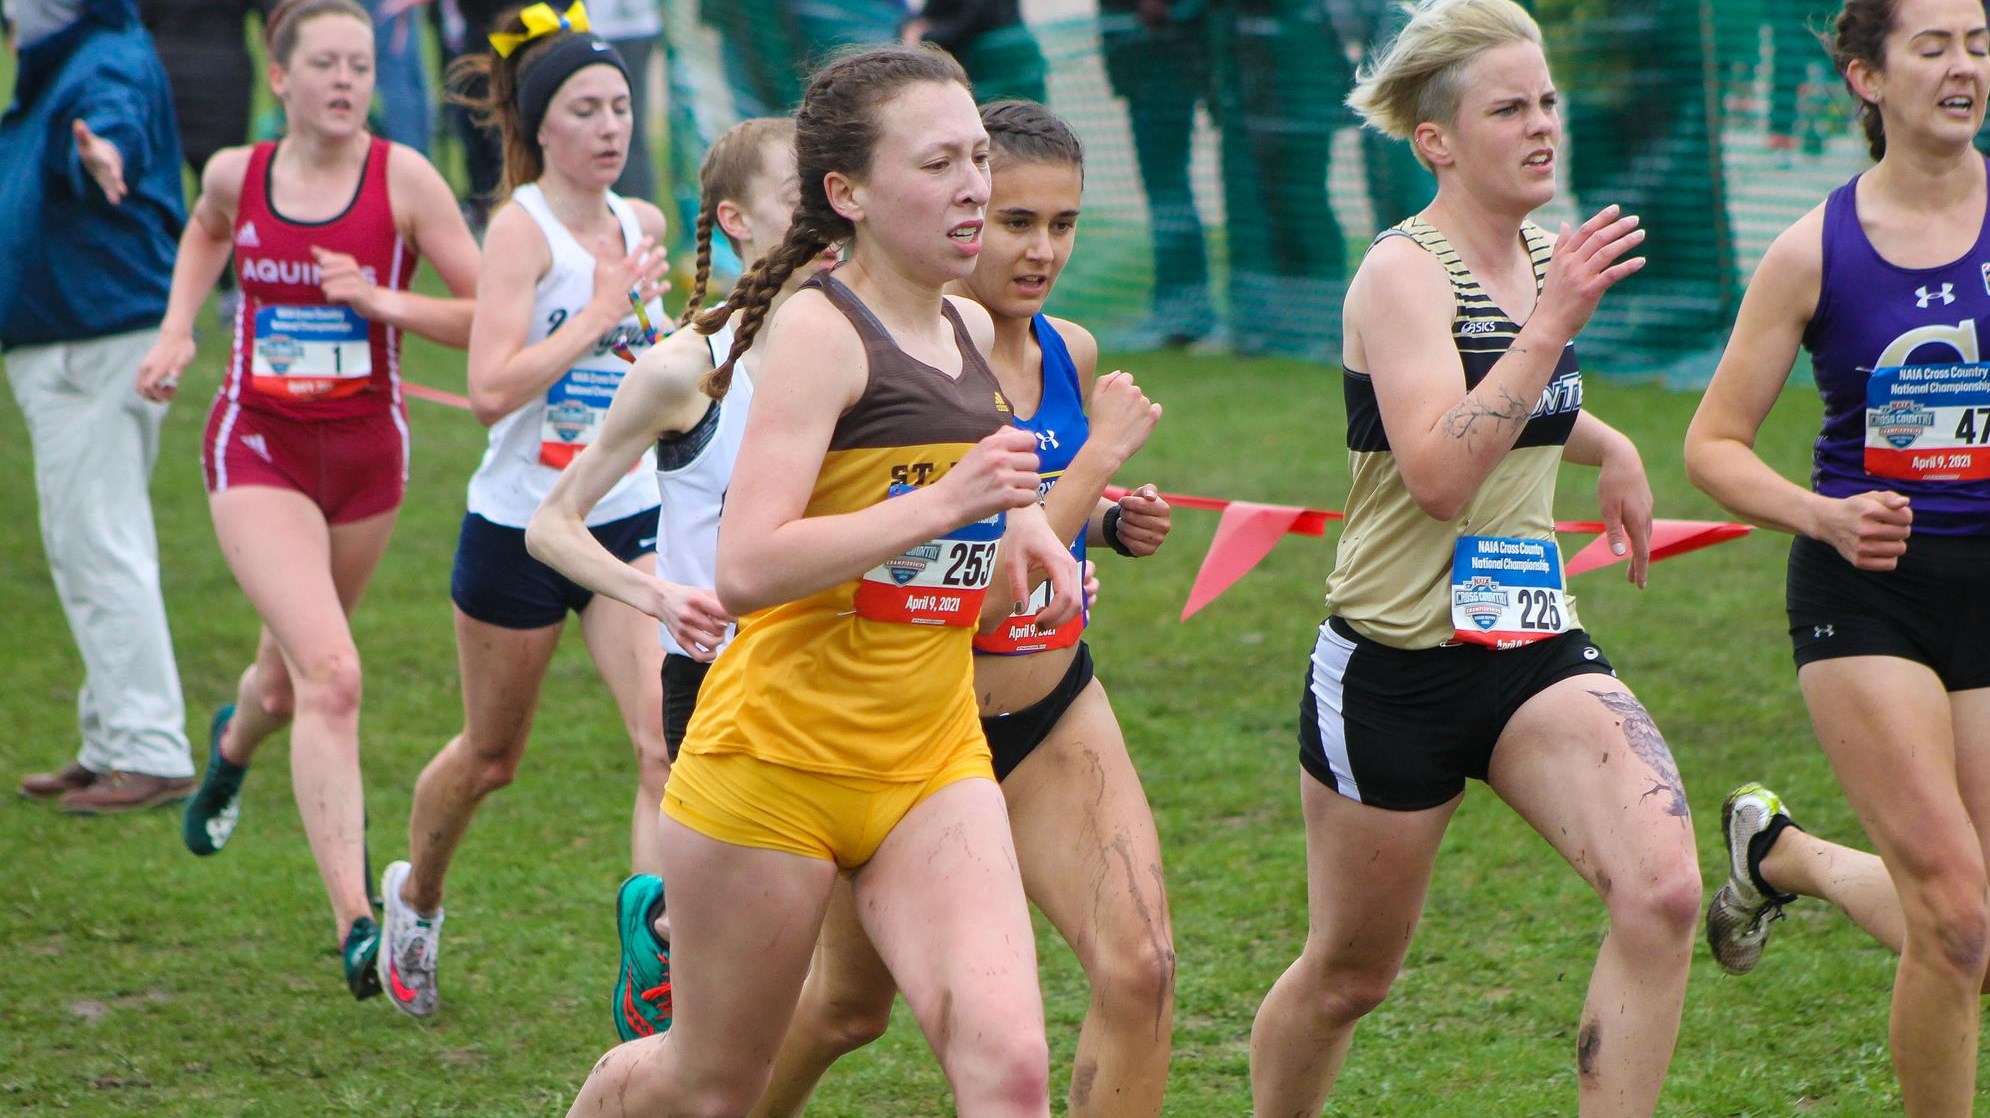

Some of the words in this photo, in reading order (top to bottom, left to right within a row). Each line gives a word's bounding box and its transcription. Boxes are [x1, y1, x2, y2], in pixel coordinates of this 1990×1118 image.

[243, 257, 377, 287] AQUIS
[1899, 368, 1922, 381] NAIA
[1923, 367, 1949, 380] Cross
[1950, 365, 1989, 380] Country
[1890, 382, 1929, 395] National
[1911, 455, 1936, 471] April
[1937, 454, 1947, 469] 9,
[1948, 454, 1972, 468] 2021
[1478, 540, 1499, 554] NAIA
[1499, 541, 1520, 555] Cross
[1519, 541, 1545, 558] Country
[942, 542, 996, 587] 253
[1471, 556, 1503, 570] National
[904, 594, 928, 612] April
[929, 596, 938, 612] 9,
[938, 597, 961, 612] 2021
[1518, 589, 1561, 631] 226
[1008, 623, 1030, 641] April
[1030, 623, 1037, 638] 9,
